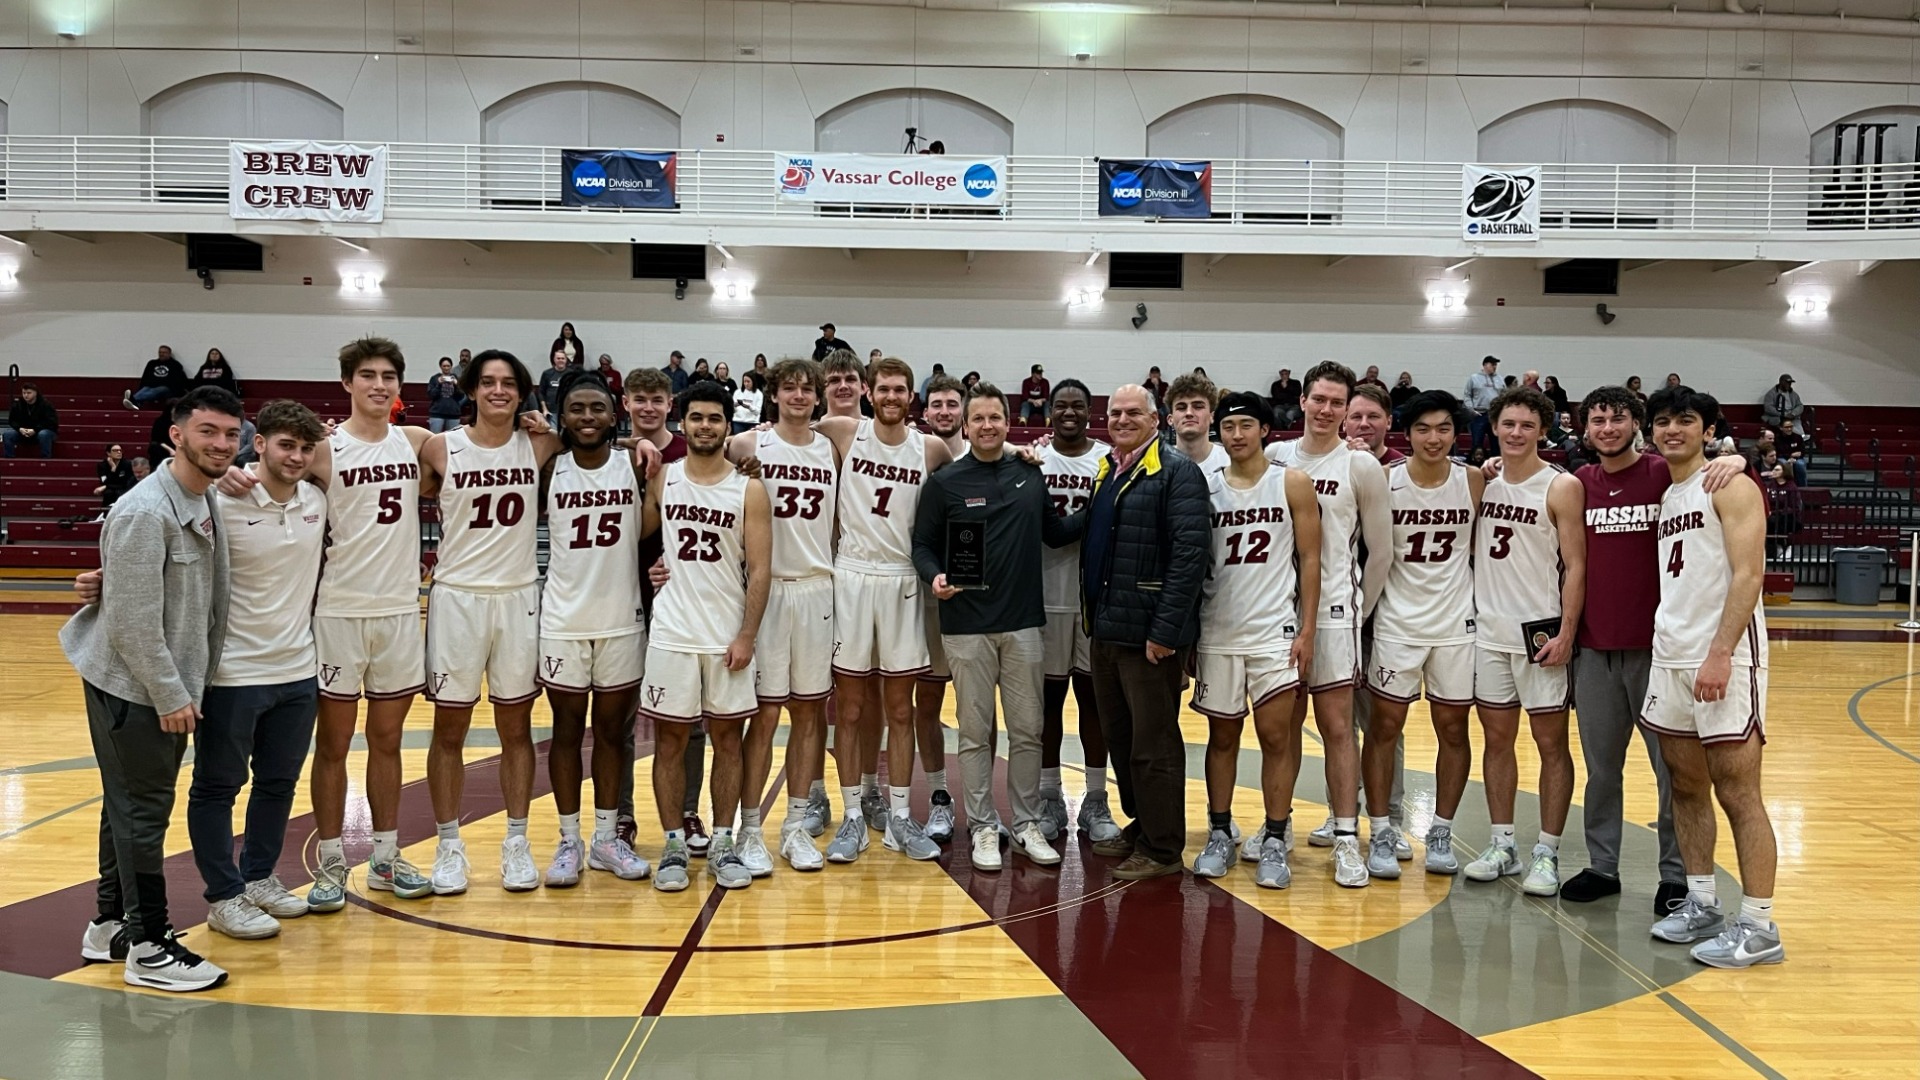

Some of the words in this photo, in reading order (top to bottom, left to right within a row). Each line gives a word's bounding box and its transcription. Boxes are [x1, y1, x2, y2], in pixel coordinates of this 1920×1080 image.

[243, 152, 373, 177] BREW
[576, 178, 606, 187] NCAA
[609, 178, 643, 188] Division
[645, 179, 653, 188] III
[822, 168, 881, 184] Vassar
[888, 170, 957, 190] College
[967, 180, 997, 189] NCAA
[244, 184, 373, 210] CREW
[1112, 188, 1142, 198] NCAA
[1145, 188, 1179, 199] Division
[1481, 223, 1533, 234] BASKETBALL
[339, 463, 418, 488] VASSAR
[452, 468, 535, 489] VASSAR
[762, 464, 832, 486] VASSAR
[852, 457, 922, 486] VASSAR
[1043, 473, 1092, 491] ASSA
[376, 487, 402, 525] 5
[469, 492, 525, 530] 10
[554, 489, 634, 509] VASSAR
[773, 486, 825, 521] 33
[871, 487, 894, 519] 1
[665, 504, 736, 529] VASSAR
[1211, 507, 1284, 528] VASSAR
[1392, 509, 1470, 525] VASSAR
[1480, 501, 1539, 525] VASSAR
[1585, 503, 1660, 526] VASSAR
[569, 512, 623, 550] 15
[1595, 522, 1650, 534] BASKETBALL
[677, 527, 723, 563] 23
[1224, 530, 1272, 566] 12
[1403, 531, 1457, 563] 13
[1489, 525, 1514, 560] 3
[1666, 539, 1685, 579] 4
